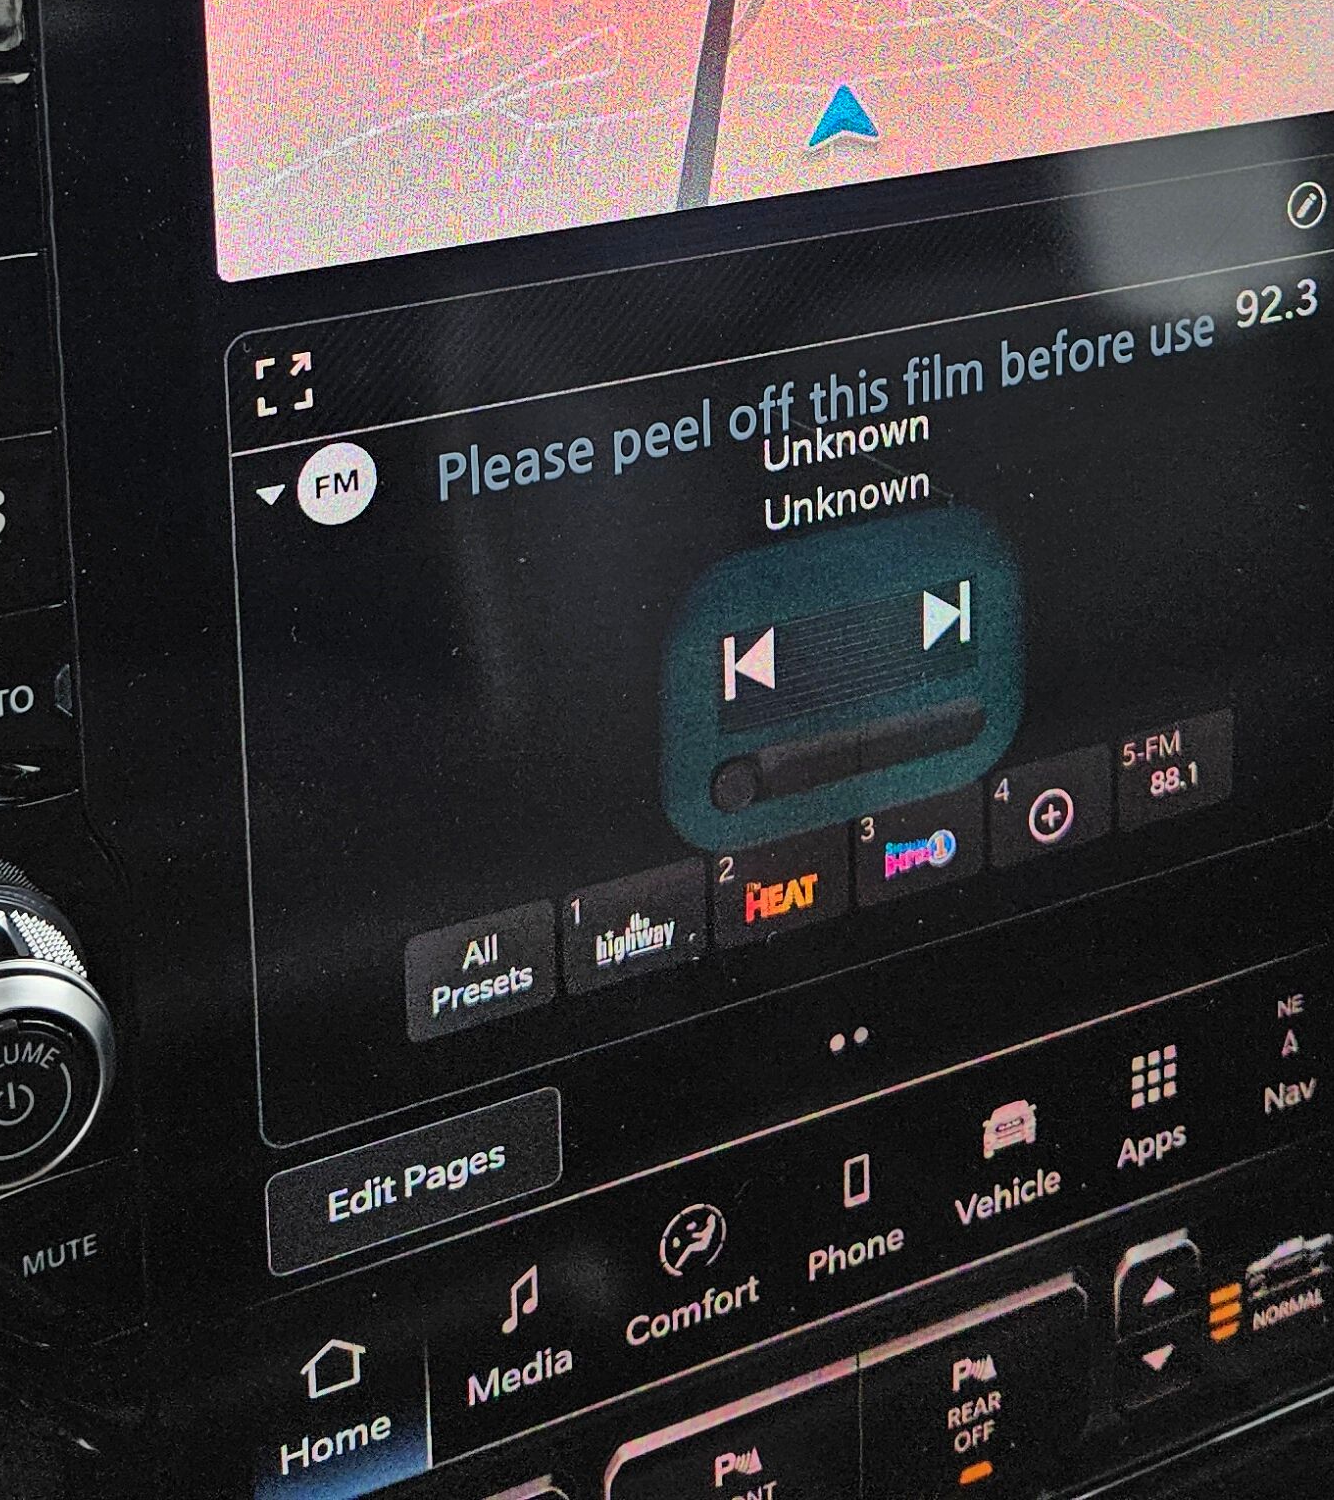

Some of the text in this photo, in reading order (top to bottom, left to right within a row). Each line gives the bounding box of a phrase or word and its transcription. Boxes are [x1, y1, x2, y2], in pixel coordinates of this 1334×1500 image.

[1236, 278, 1319, 328] 92.3
[439, 315, 1216, 501] Please peel off this film before use
[763, 412, 929, 472] Unknown
[314, 469, 360, 499] FM
[764, 471, 930, 531] Unknown
[1122, 730, 1180, 767] 5-FM
[994, 777, 1011, 803] 4
[1150, 761, 1198, 797] 88.1
[860, 816, 875, 842] 3
[719, 856, 735, 883] 2
[571, 898, 582, 925] 1
[745, 873, 817, 924] HEAT
[462, 933, 498, 971] All
[596, 920, 675, 964] highway
[432, 964, 534, 1018] Presets
[1277, 994, 1304, 1018] NE
[1264, 1077, 1317, 1114] Nav
[1117, 1125, 1187, 1169] Apps
[328, 1143, 506, 1223] Edit Pages
[955, 1168, 1062, 1226] Vehicle
[22, 1233, 98, 1278] MUTE
[808, 1227, 905, 1281] Phone
[625, 1275, 760, 1347] Comfort
[1252, 1287, 1324, 1331] NORMAL
[467, 1346, 573, 1406] Media
[947, 1392, 1001, 1429] REAR
[280, 1412, 392, 1476] Home
[953, 1421, 996, 1453] OFF
